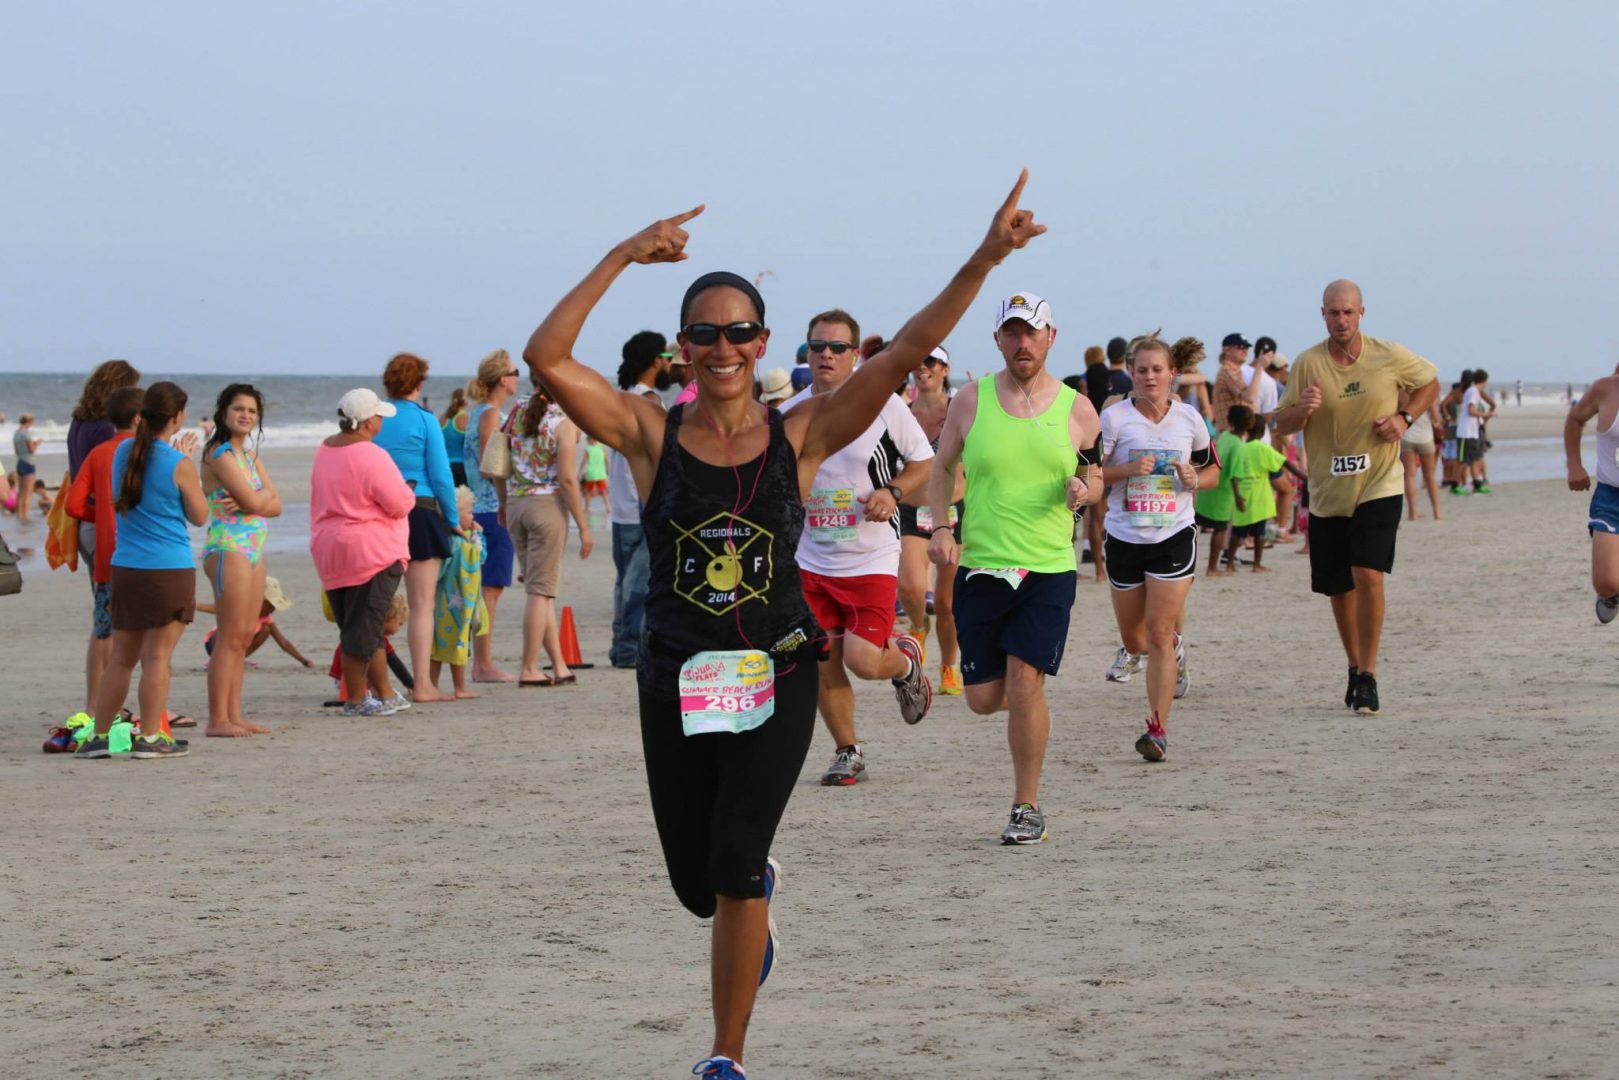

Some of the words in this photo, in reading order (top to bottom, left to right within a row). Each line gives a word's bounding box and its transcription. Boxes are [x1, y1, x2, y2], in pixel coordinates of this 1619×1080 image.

[1344, 381, 1360, 393] JU
[1333, 455, 1366, 473] 2157
[1135, 501, 1169, 512] 1197
[815, 515, 848, 527] 1248
[700, 528, 751, 538] REGIONALS
[684, 558, 695, 573] C
[754, 556, 763, 573] F
[708, 591, 736, 603] 2014
[681, 686, 719, 694] SUMMER
[722, 685, 752, 695] BEACH
[754, 679, 772, 690] RUN
[705, 695, 756, 713] 296
